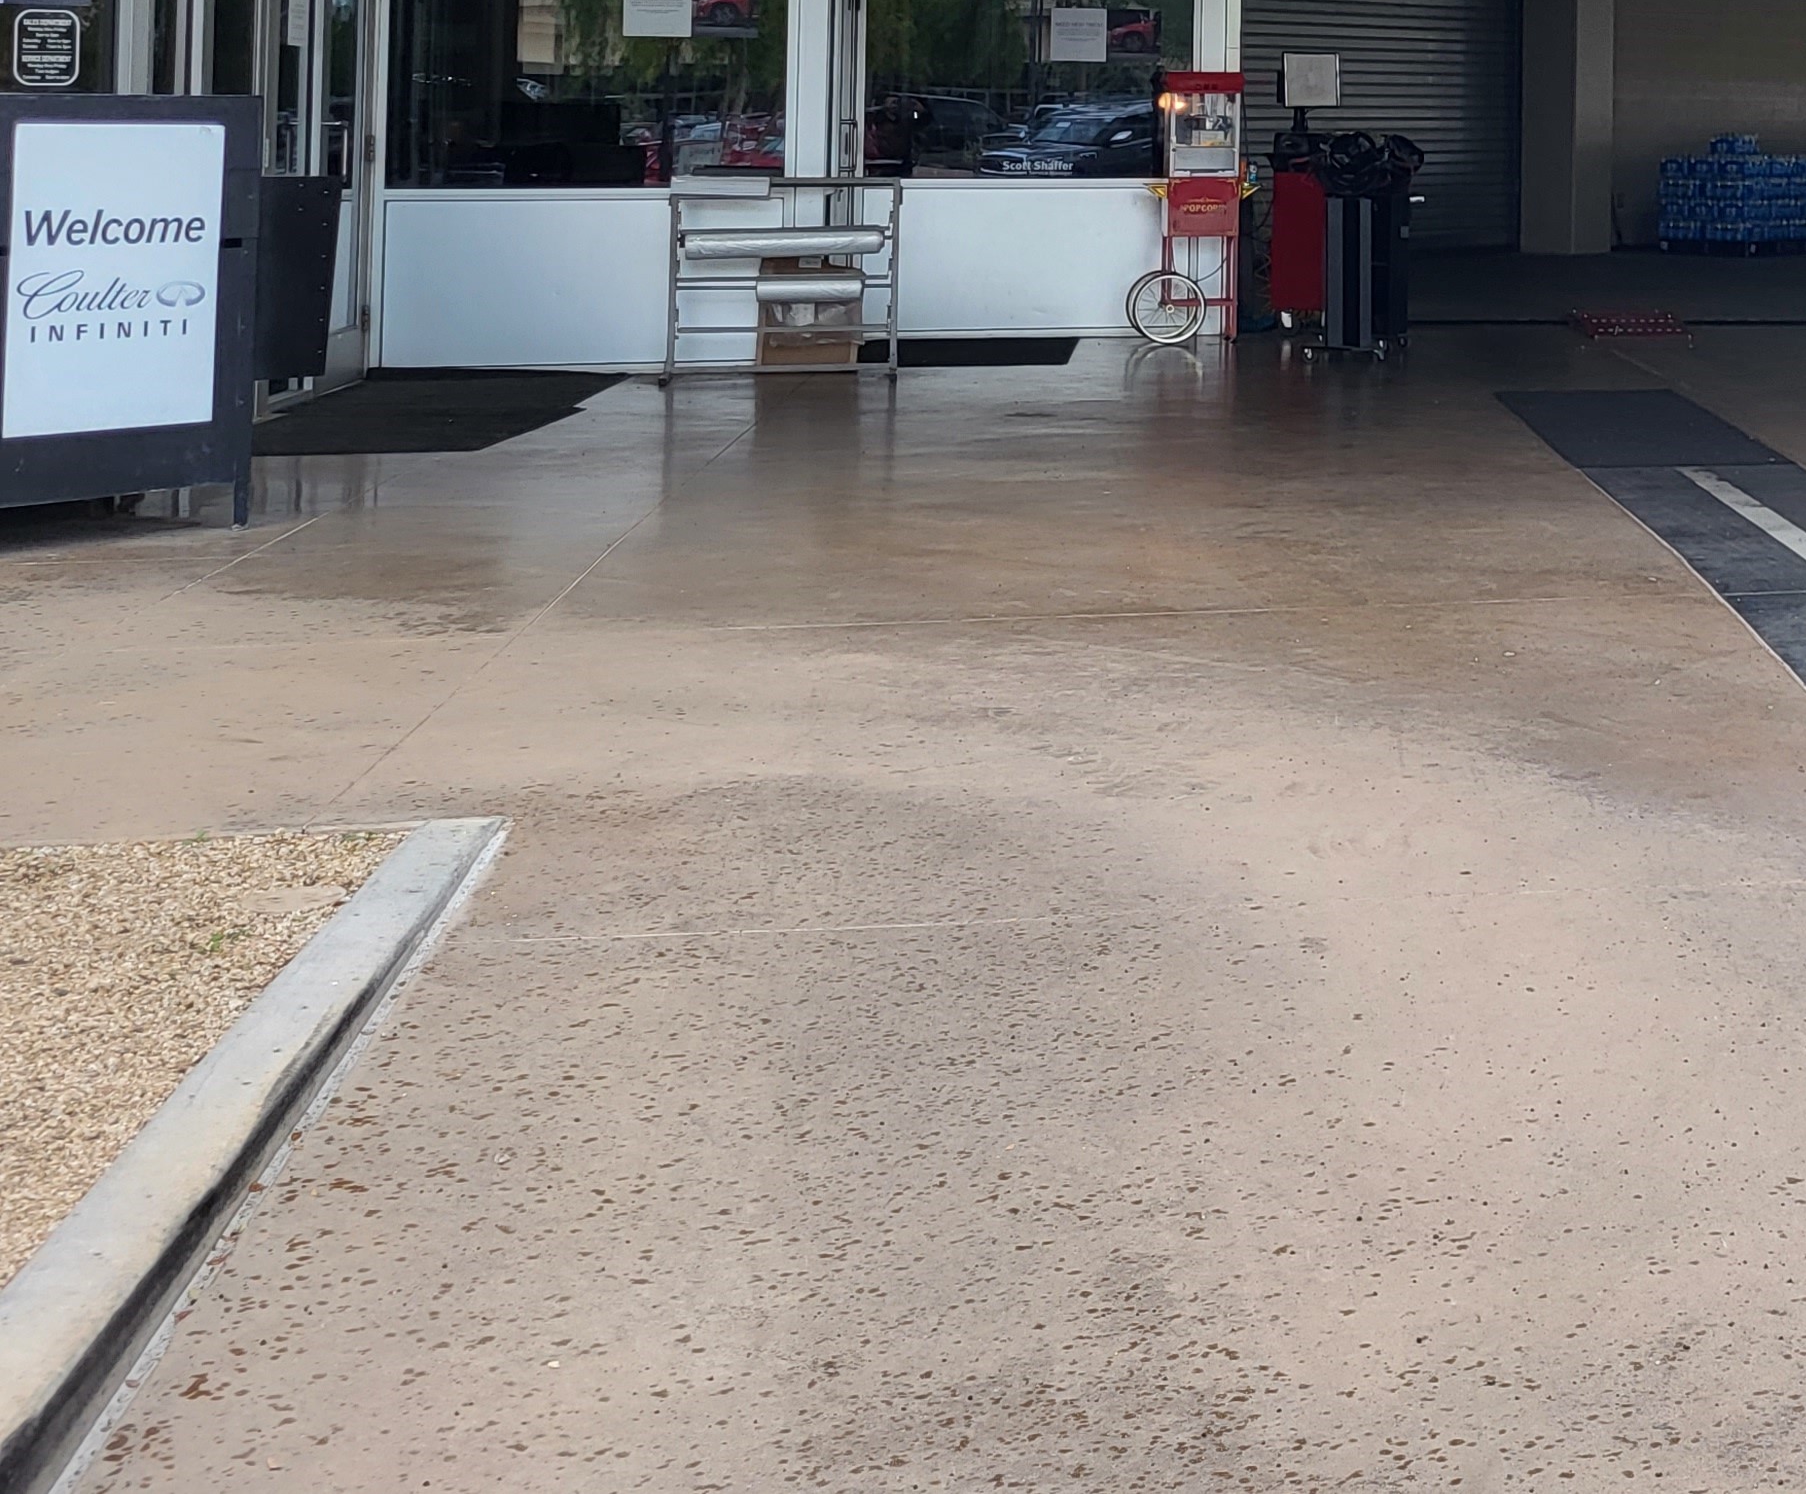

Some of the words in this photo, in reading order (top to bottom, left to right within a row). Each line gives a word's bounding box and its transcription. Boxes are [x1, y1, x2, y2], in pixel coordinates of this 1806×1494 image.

[1002, 160, 1031, 171] Scott
[1033, 159, 1074, 171] Shaffer
[24, 209, 206, 246] Welcome
[16, 269, 152, 320] Coulter
[30, 318, 188, 344] INFINITI
